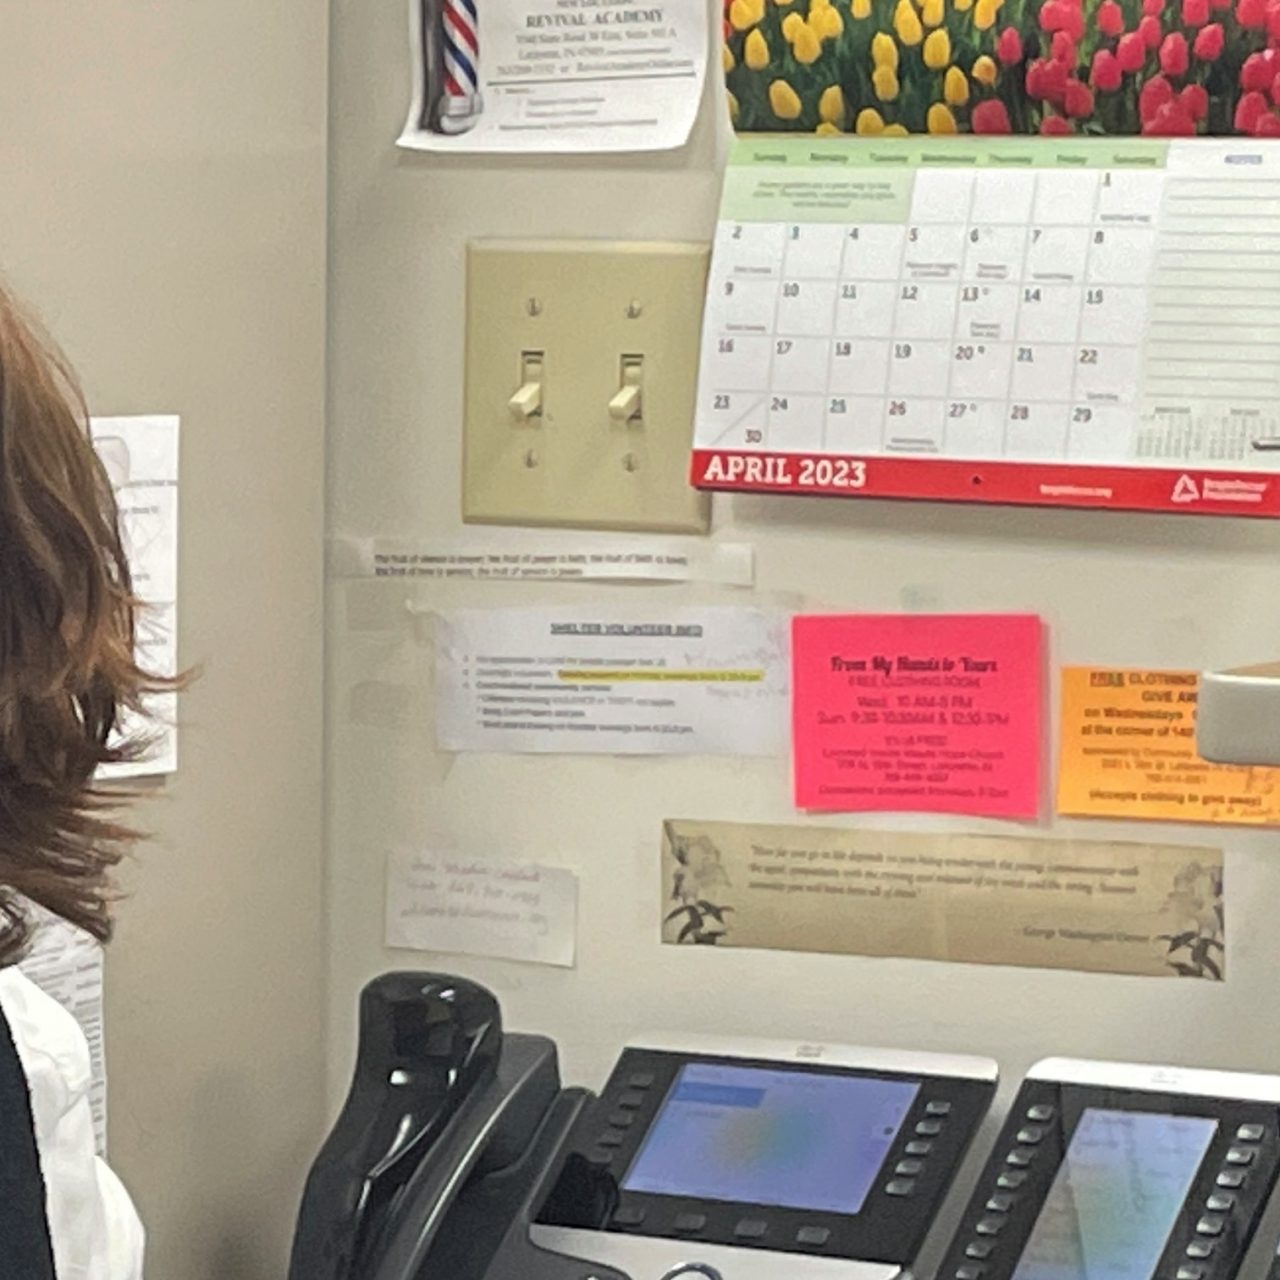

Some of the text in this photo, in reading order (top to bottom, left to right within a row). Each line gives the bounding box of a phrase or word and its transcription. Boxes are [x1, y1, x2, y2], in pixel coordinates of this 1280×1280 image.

[526, 9, 664, 28] REVIVAL ACADEMY
[1102, 172, 1112, 188] 1
[731, 225, 743, 240] 2
[848, 227, 859, 241] 4
[908, 227, 919, 243] 5
[969, 228, 980, 243] 6
[1032, 229, 1042, 244] 7
[725, 281, 1104, 305] 9 10 11 12 13 14 15
[718, 338, 734, 354] 16
[776, 340, 793, 355] 17
[895, 343, 912, 359] 19
[954, 345, 974, 361] 20
[1079, 348, 1098, 365] 22
[713, 394, 731, 410] 23
[770, 396, 788, 412] 24
[888, 400, 907, 416] 26
[948, 402, 968, 418] 27
[1072, 407, 1093, 423] 29
[704, 455, 867, 487] APRIL 2023
[550, 623, 602, 635] SHELTER
[605, 624, 671, 636] VOLUNTEER
[873, 656, 892, 676] My
[1090, 672, 1197, 687] FREE CLOTHING
[1141, 690, 1172, 703] GIVE
